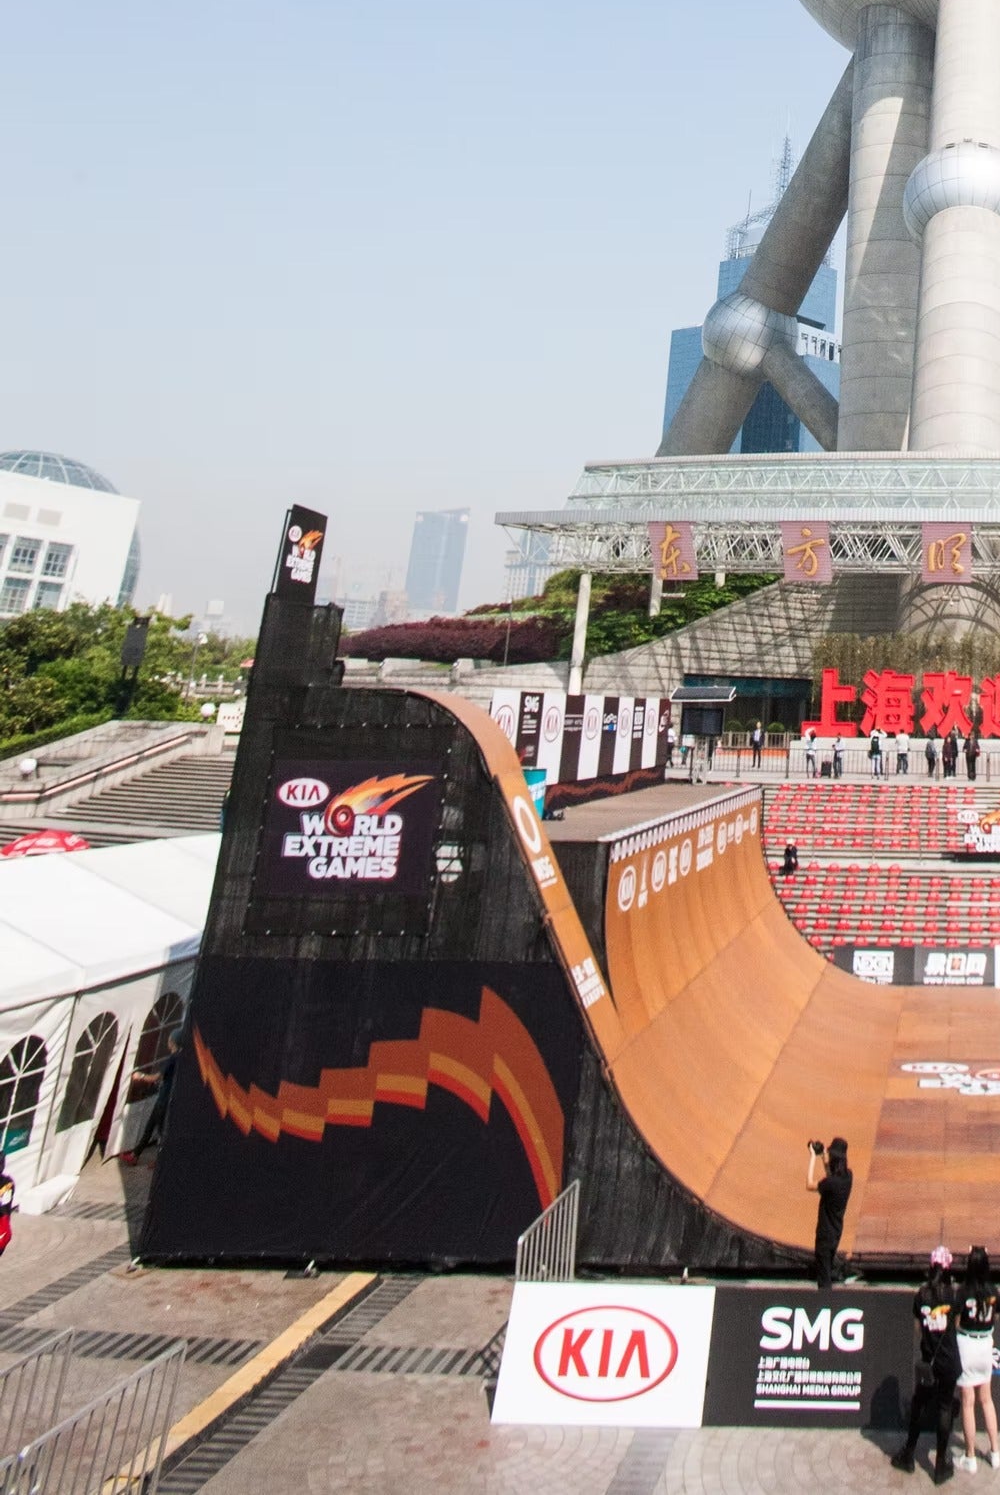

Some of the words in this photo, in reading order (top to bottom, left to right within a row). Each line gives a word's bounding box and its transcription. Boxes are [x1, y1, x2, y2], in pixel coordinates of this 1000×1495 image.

[286, 784, 321, 801] KIA
[302, 810, 403, 836] WORLD
[283, 834, 400, 857] EXTREME
[308, 856, 398, 879] GAMES
[760, 1306, 864, 1352] SMG
[558, 1328, 650, 1378] KIA
[756, 1384, 801, 1395] SHANGHAI
[802, 1384, 830, 1396] MEDIA
[831, 1385, 861, 1397] GROUP
